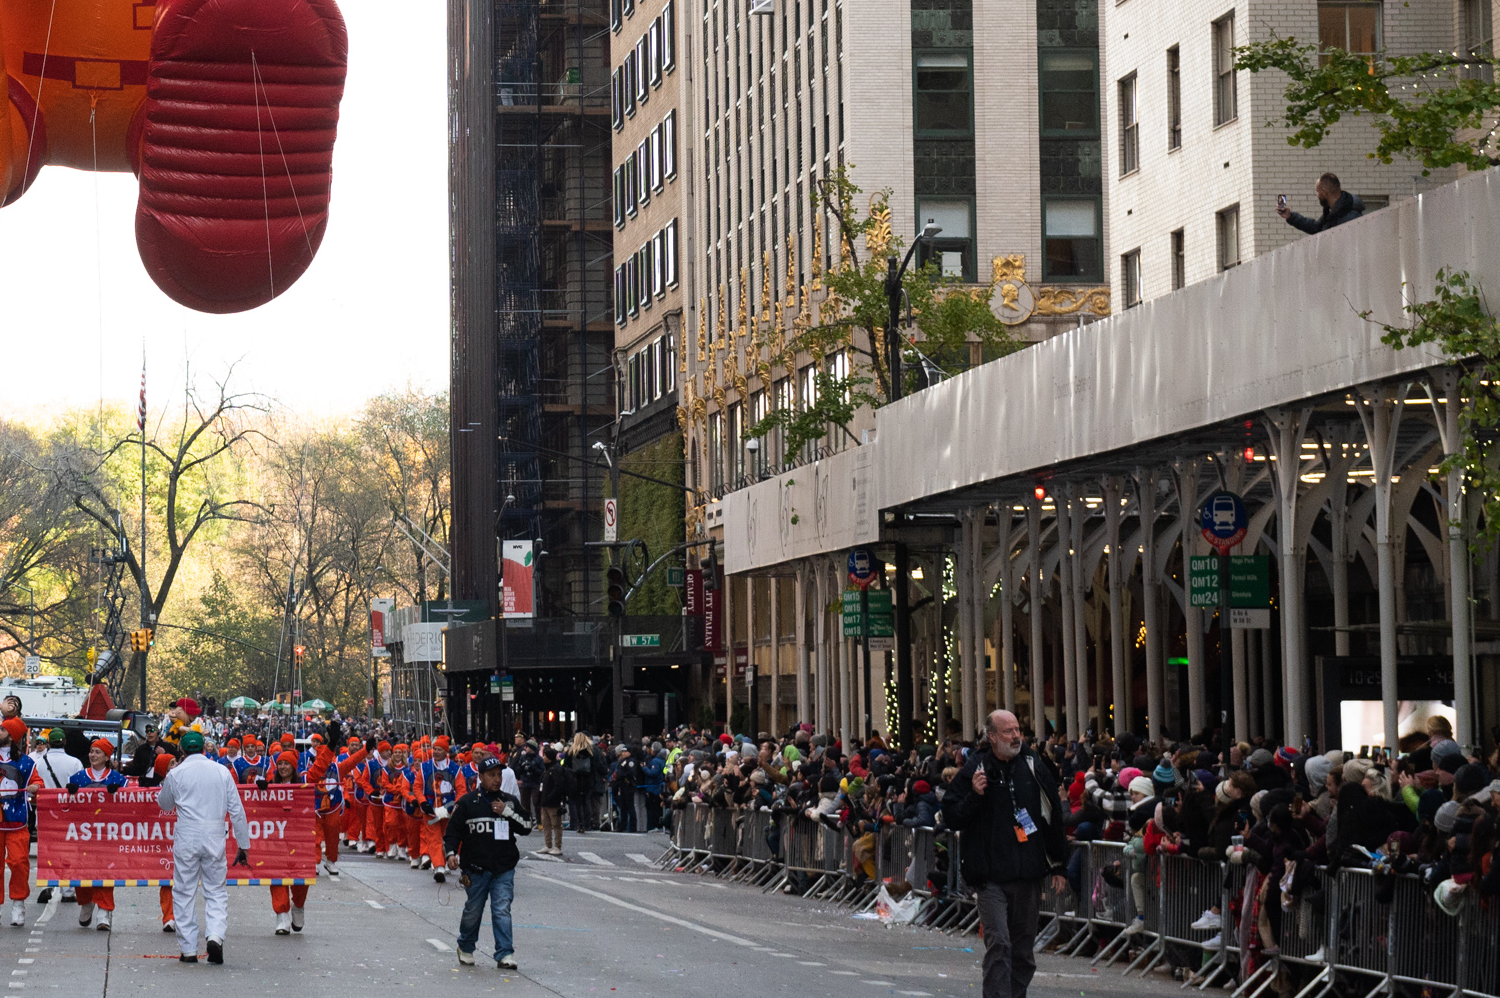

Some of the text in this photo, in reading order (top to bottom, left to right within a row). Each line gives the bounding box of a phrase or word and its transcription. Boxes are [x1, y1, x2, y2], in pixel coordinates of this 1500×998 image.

[1191, 558, 1218, 571] QM10
[1191, 574, 1218, 588] QM12
[687, 573, 695, 612] QUALITY
[843, 592, 860, 602] QM15
[1191, 591, 1218, 605] QM24
[844, 602, 861, 613] QM16
[843, 614, 861, 624] QM17
[705, 611, 713, 647] ITALIAN
[844, 626, 861, 636] QM18
[630, 636, 638, 645] W
[641, 636, 652, 645] 57
[27, 665, 39, 673] 20
[57, 789, 294, 804] MACY'S THANKS PARADE
[65, 821, 177, 841] ASTRONAU
[468, 821, 494, 834] POL
[119, 844, 162, 854] PEANUTS
